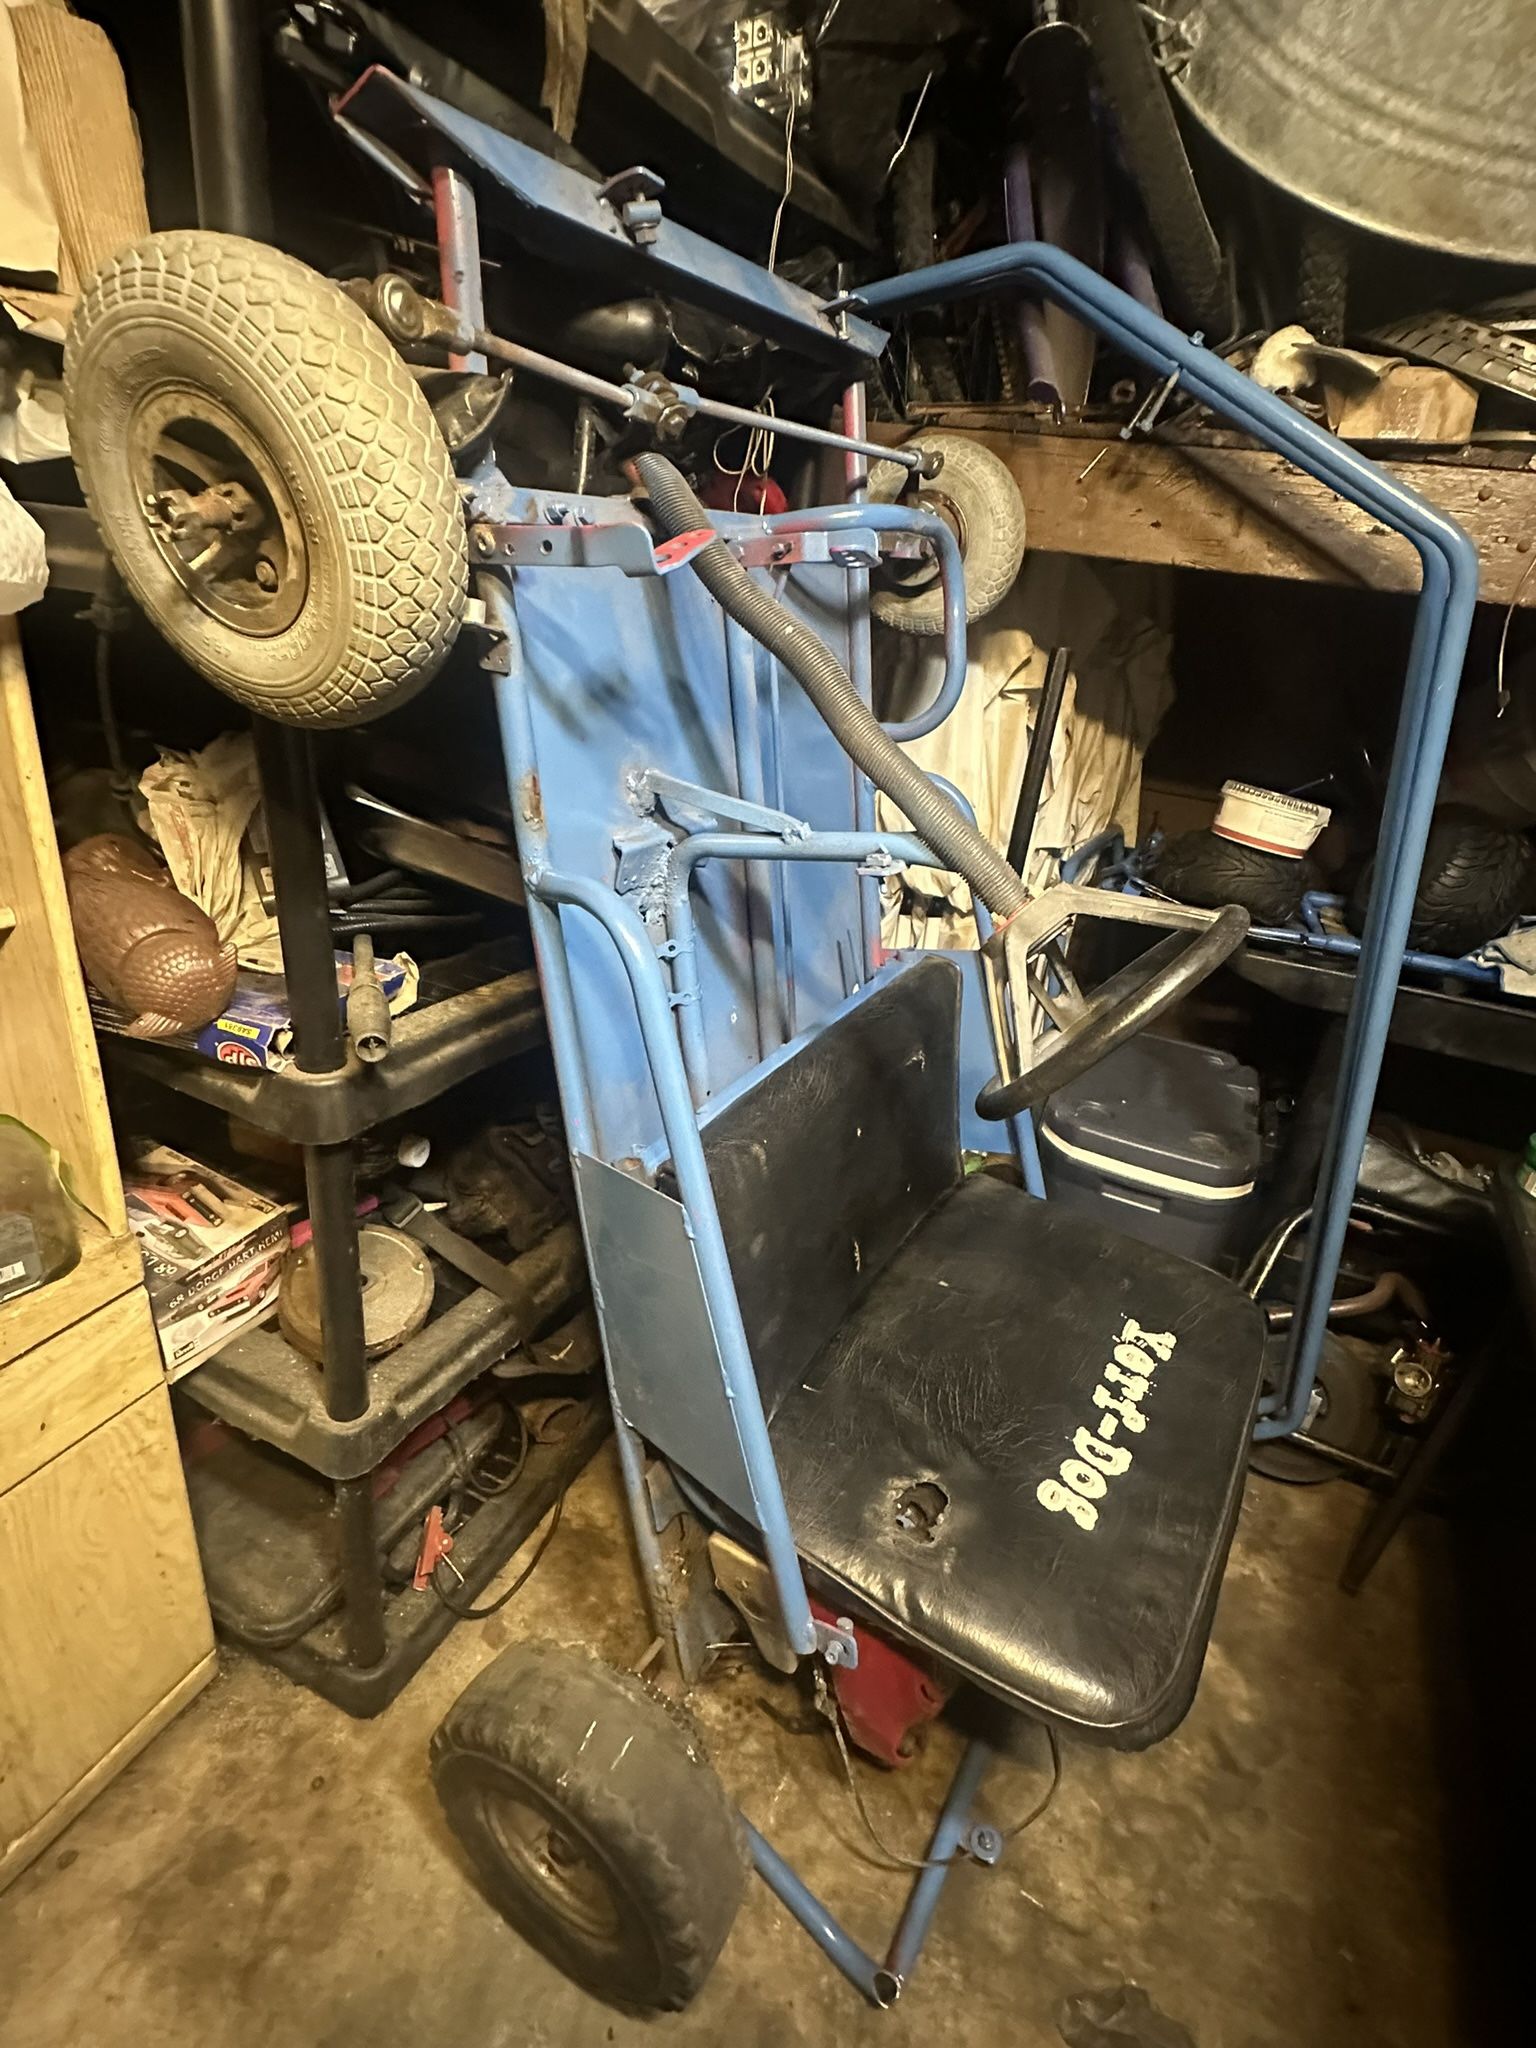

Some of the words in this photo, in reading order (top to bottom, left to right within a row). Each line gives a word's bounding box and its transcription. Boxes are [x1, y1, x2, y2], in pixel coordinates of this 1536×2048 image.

[187, 1266, 225, 1297] DODGE
[228, 1247, 255, 1270] DART
[258, 1229, 283, 1252] HEMI
